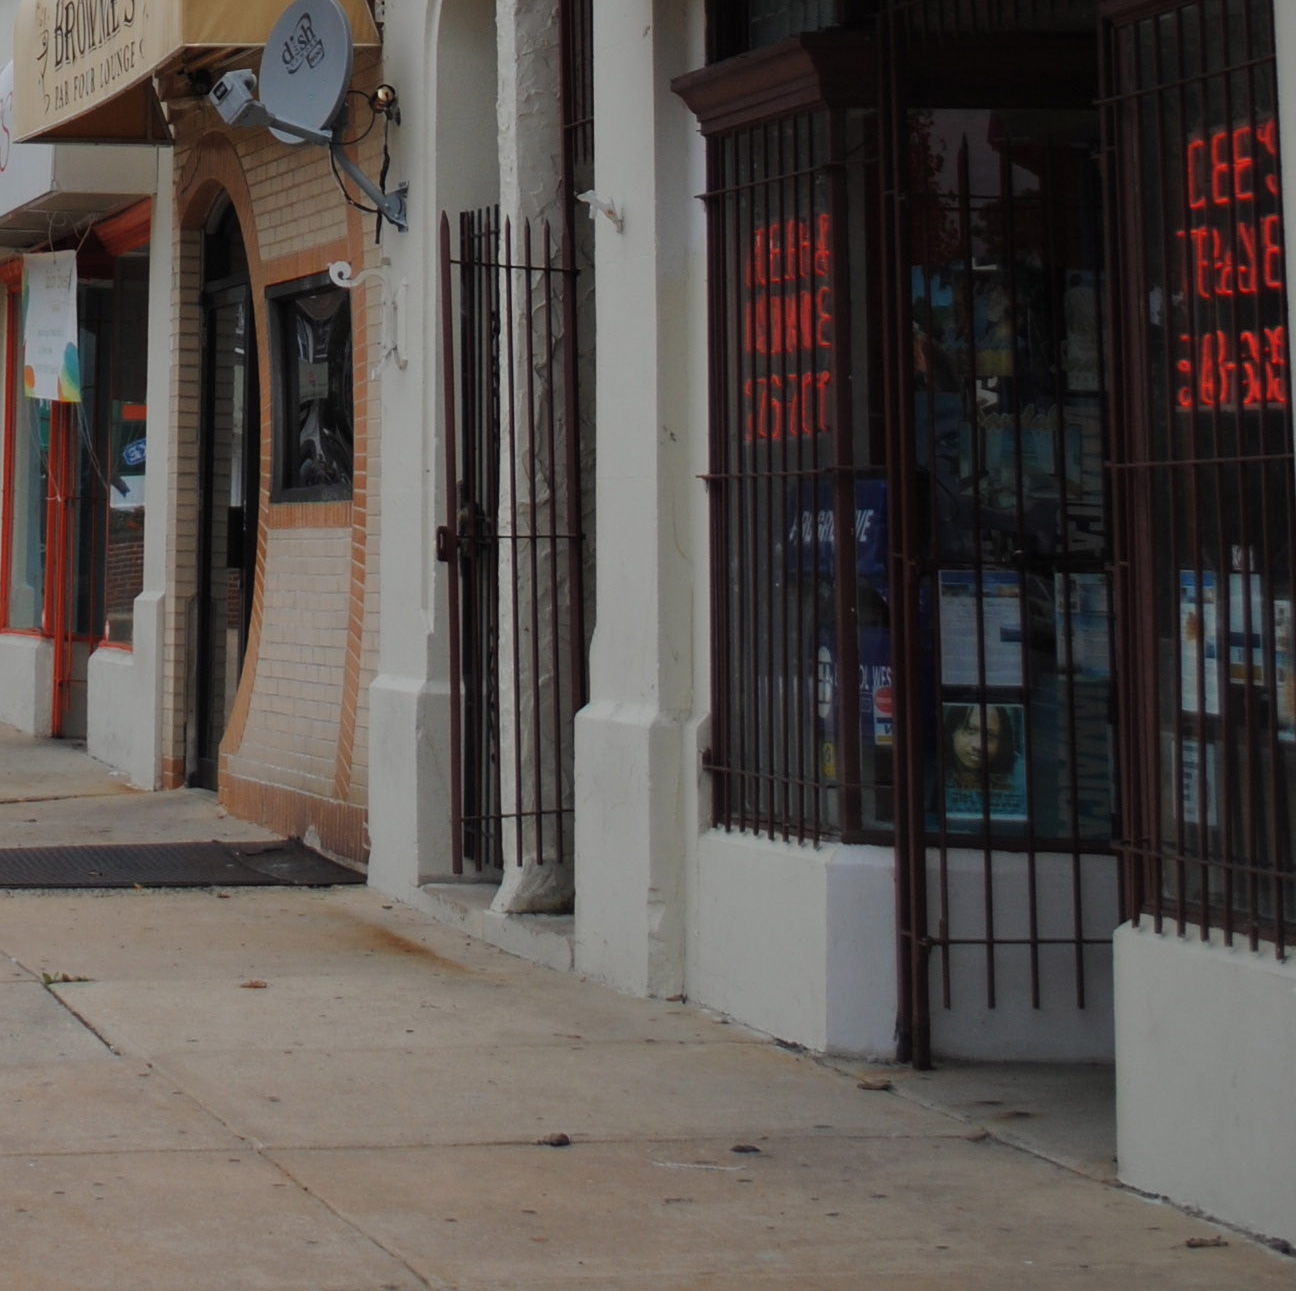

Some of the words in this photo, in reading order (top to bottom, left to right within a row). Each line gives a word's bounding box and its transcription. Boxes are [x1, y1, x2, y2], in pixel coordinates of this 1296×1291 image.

[54, 80, 72, 111] PAR
[73, 66, 96, 102] FOUR
[100, 40, 136, 88] LOUNGE
